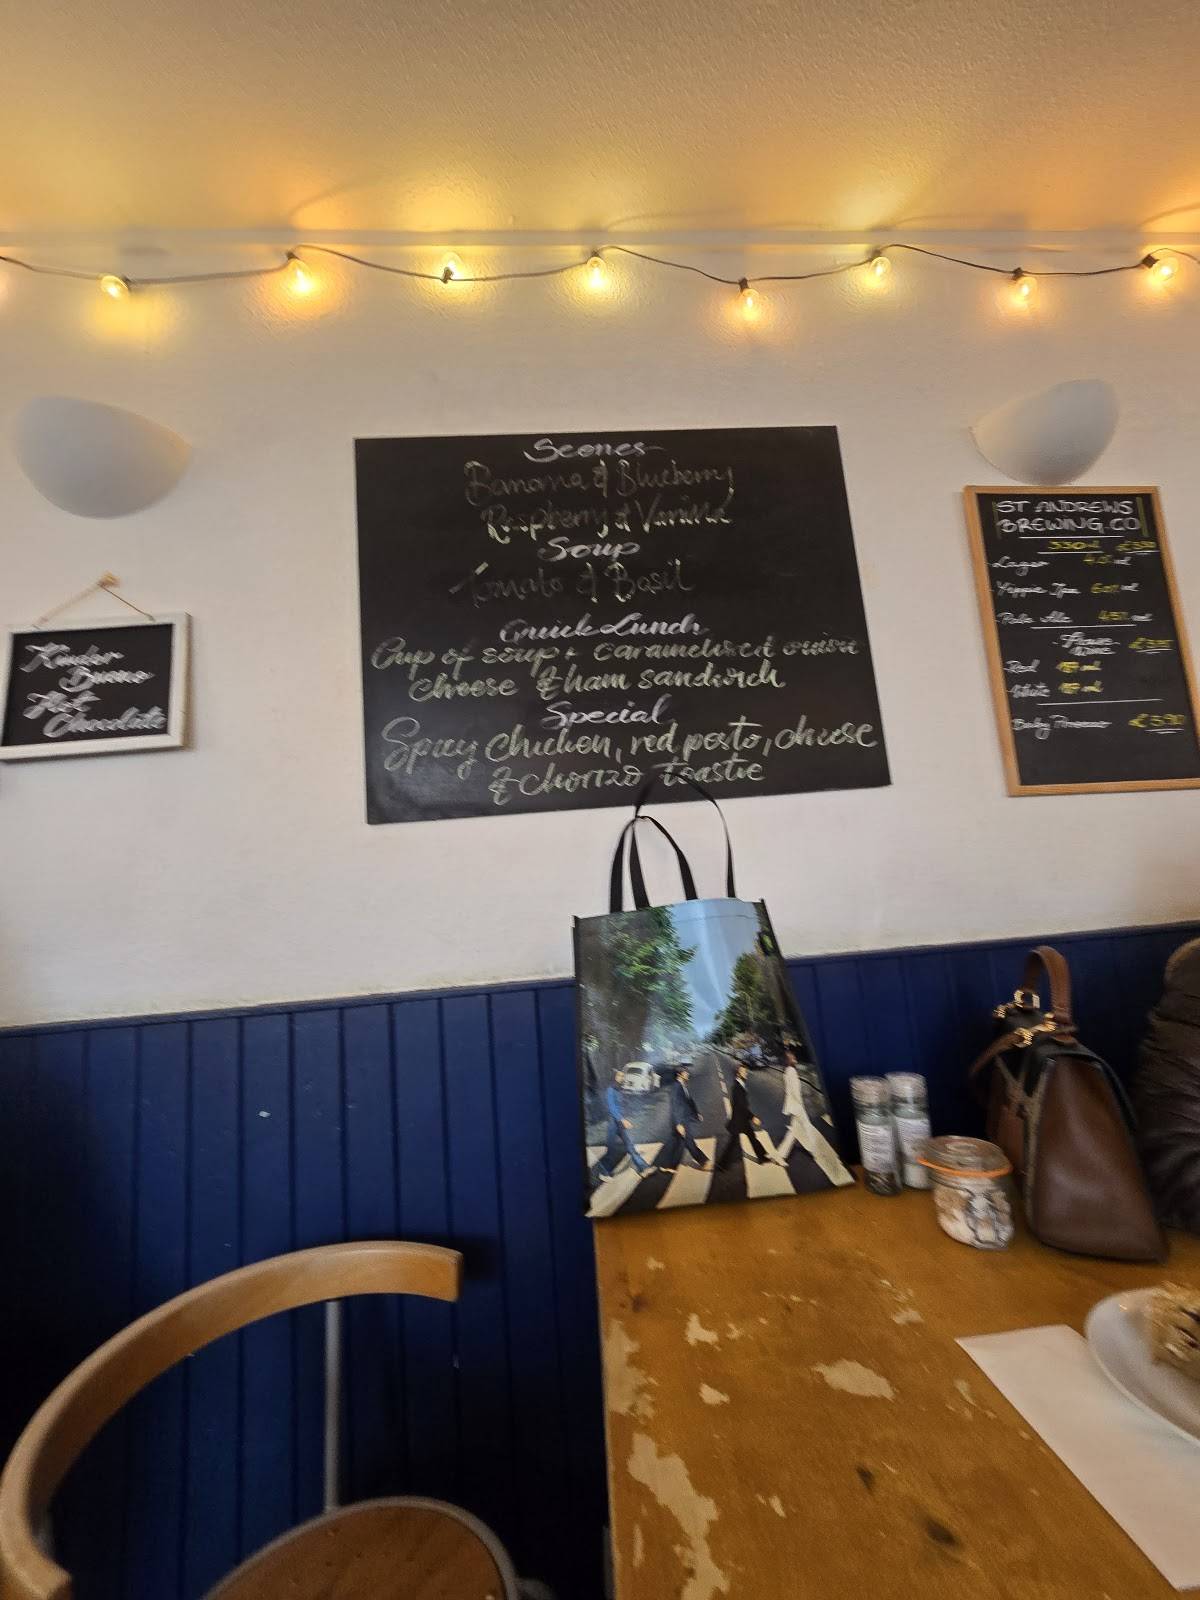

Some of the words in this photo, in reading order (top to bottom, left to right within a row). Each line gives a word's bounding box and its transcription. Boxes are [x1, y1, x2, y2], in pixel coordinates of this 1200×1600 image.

[524, 438, 664, 463] Scones
[464, 461, 588, 506] Banana
[616, 459, 734, 506] Blueberry
[996, 501, 1030, 513] ST
[1035, 500, 1133, 514] ANDREWS
[998, 517, 1104, 534] BREWING
[1109, 517, 1140, 531] CO
[538, 537, 640, 562] Soup
[604, 559, 695, 603] Basil
[500, 616, 600, 643] Quick
[600, 612, 706, 636] Lunch
[20, 642, 125, 673] Kinder
[371, 636, 435, 680] Cup
[441, 639, 475, 680] of
[481, 647, 559, 677] soup
[58, 666, 156, 693] Bueno
[563, 664, 629, 693] ham
[23, 690, 101, 719] Hot
[541, 694, 672, 730] Special
[43, 706, 168, 738] Chocolate
[630, 719, 679, 755] red
[488, 764, 519, 806] &
